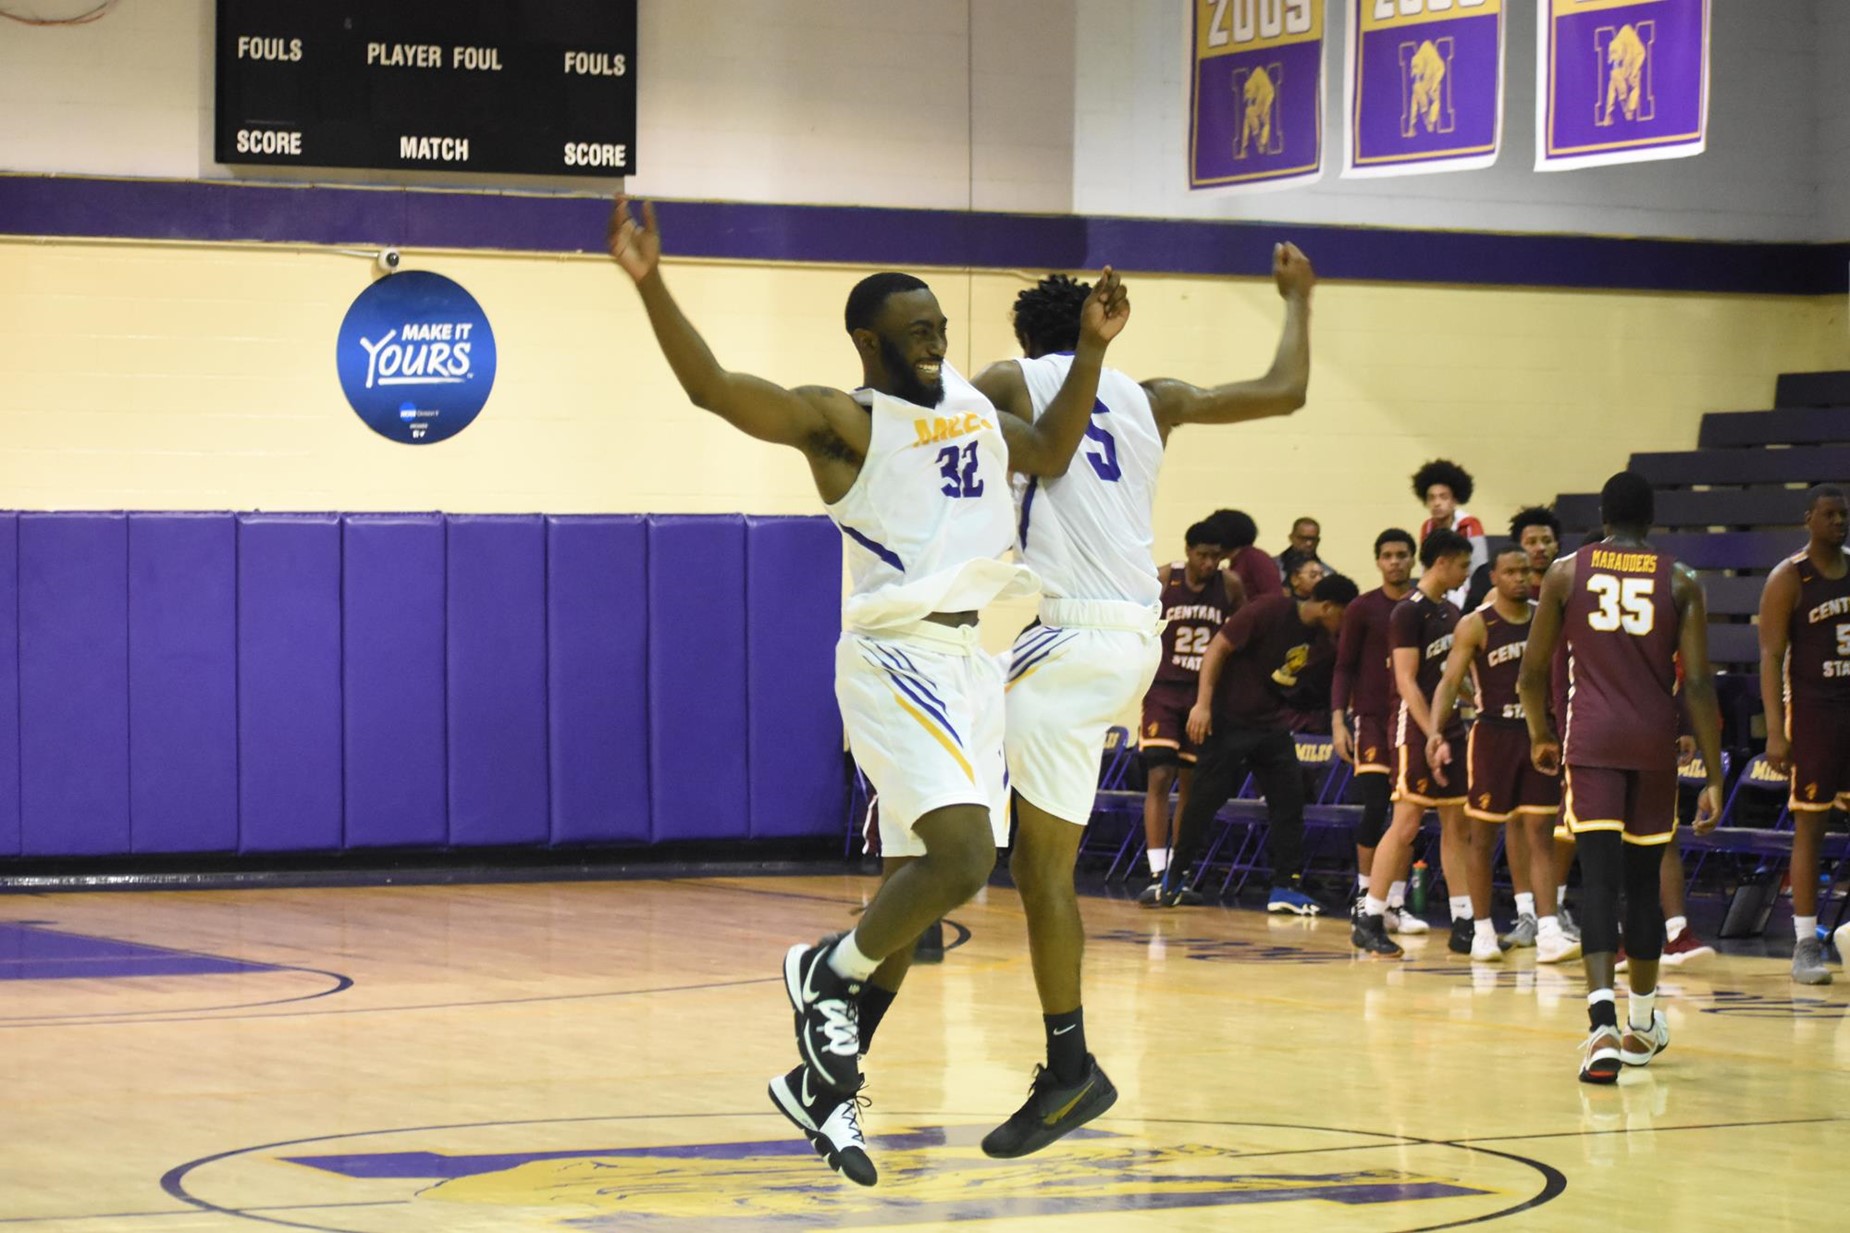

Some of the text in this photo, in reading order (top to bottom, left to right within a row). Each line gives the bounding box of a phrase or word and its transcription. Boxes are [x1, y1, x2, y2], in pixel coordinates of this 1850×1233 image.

[238, 36, 302, 62] FOULS
[367, 43, 502, 71] PLAYER FOUL
[564, 52, 626, 76] FOULS
[237, 130, 302, 155] SCORE
[400, 137, 469, 161] MATCH
[564, 143, 626, 167] SCORE
[401, 323, 473, 341] MAKE IT
[360, 329, 471, 389] YOURS
[934, 440, 984, 498] 32
[1591, 549, 1658, 574] MARAUDERS
[1166, 604, 1222, 625] CENTRAL
[1586, 573, 1655, 636] 35
[1808, 596, 1850, 624] CENT
[1174, 626, 1211, 654] 22
[1172, 654, 1204, 671] STAT
